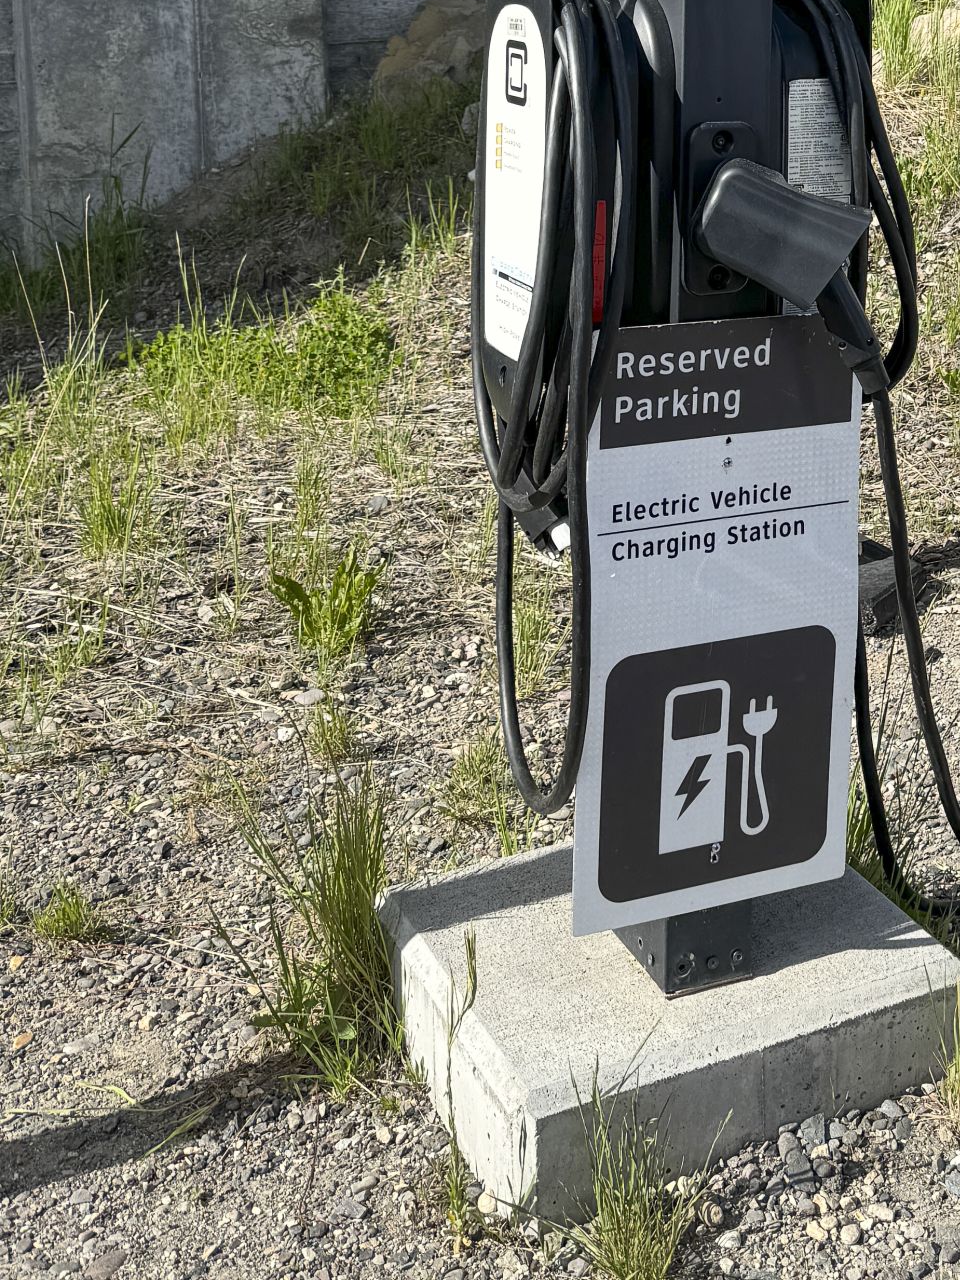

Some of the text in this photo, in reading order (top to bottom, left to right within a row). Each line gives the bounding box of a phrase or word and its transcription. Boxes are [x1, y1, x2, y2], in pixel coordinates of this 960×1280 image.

[616, 338, 771, 379] Reserved
[615, 387, 741, 423] Parking
[612, 482, 792, 523] Electric Vehicle
[611, 518, 805, 561] Charging Station
